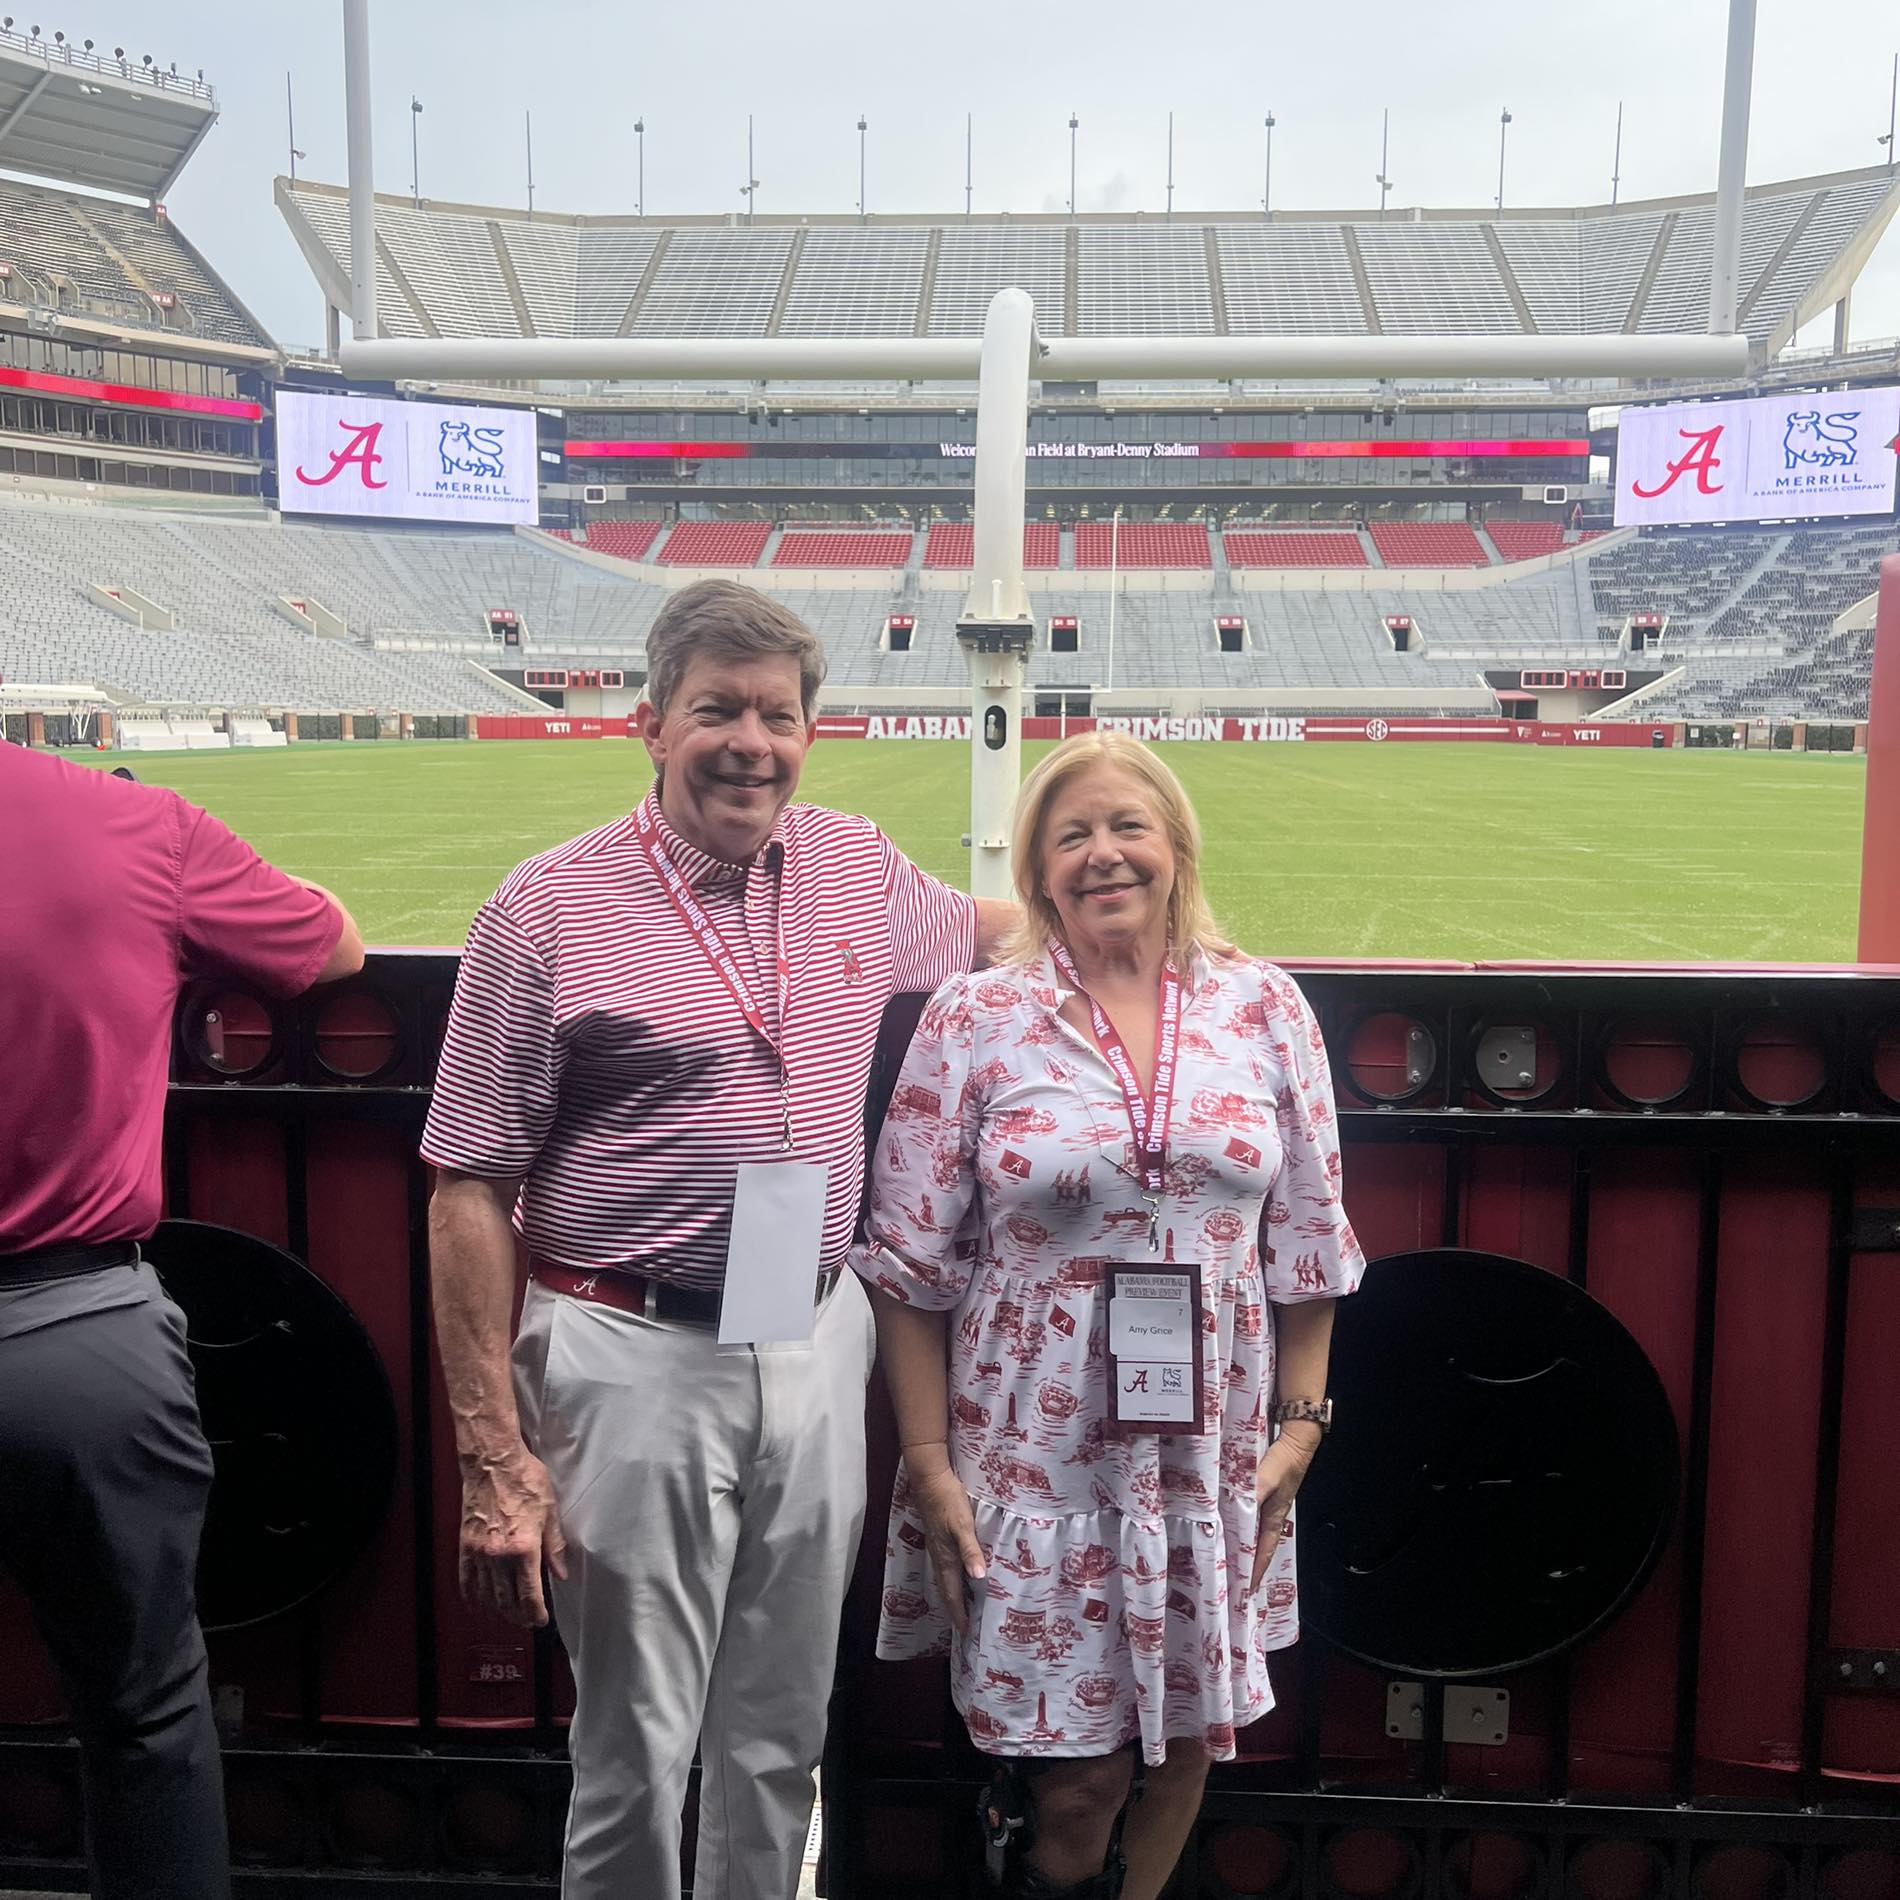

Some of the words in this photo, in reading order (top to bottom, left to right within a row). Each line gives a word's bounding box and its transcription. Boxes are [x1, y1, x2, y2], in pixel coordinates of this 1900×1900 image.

[296, 419, 388, 488] A
[1038, 443, 1063, 457] Field
[1064, 445, 1075, 457] at
[1078, 443, 1151, 458] Bryant-Denny
[1153, 443, 1199, 457] Stadium
[1631, 424, 1725, 498] A
[436, 481, 511, 495] MERRILL
[1761, 489, 1785, 497] BANK
[1798, 486, 1839, 494] AMERICA
[1841, 484, 1886, 492] COMPANY
[1776, 473, 1863, 487] MERRILL
[456, 494, 492, 502] AMERICA
[493, 496, 530, 504] COMPANY
[545, 722, 570, 733] YETI
[1238, 717, 1306, 741] TIDE
[1368, 720, 1387, 740] SEC
[1573, 729, 1600, 741] YETI
[650, 840, 683, 893] Network
[677, 888, 708, 931] Sports
[701, 928, 725, 958] Tide
[719, 956, 755, 1012] Crimson
[1162, 980, 1179, 1021] Network
[1158, 1022, 1176, 1063] Sports
[1107, 1045, 1139, 1096] Crimson
[1130, 1097, 1147, 1128] Tide
[1154, 1065, 1172, 1093] Tide
[1146, 1095, 1168, 1152] Crimson
[1117, 1276, 1150, 1286] ALABAMA
[1152, 1277, 1189, 1287] FOOTBALL
[1124, 1287, 1157, 1297] PREVIEW
[1158, 1288, 1183, 1297] EVENT
[1128, 1326, 1148, 1335] Amy
[1124, 1369, 1149, 1393] A
